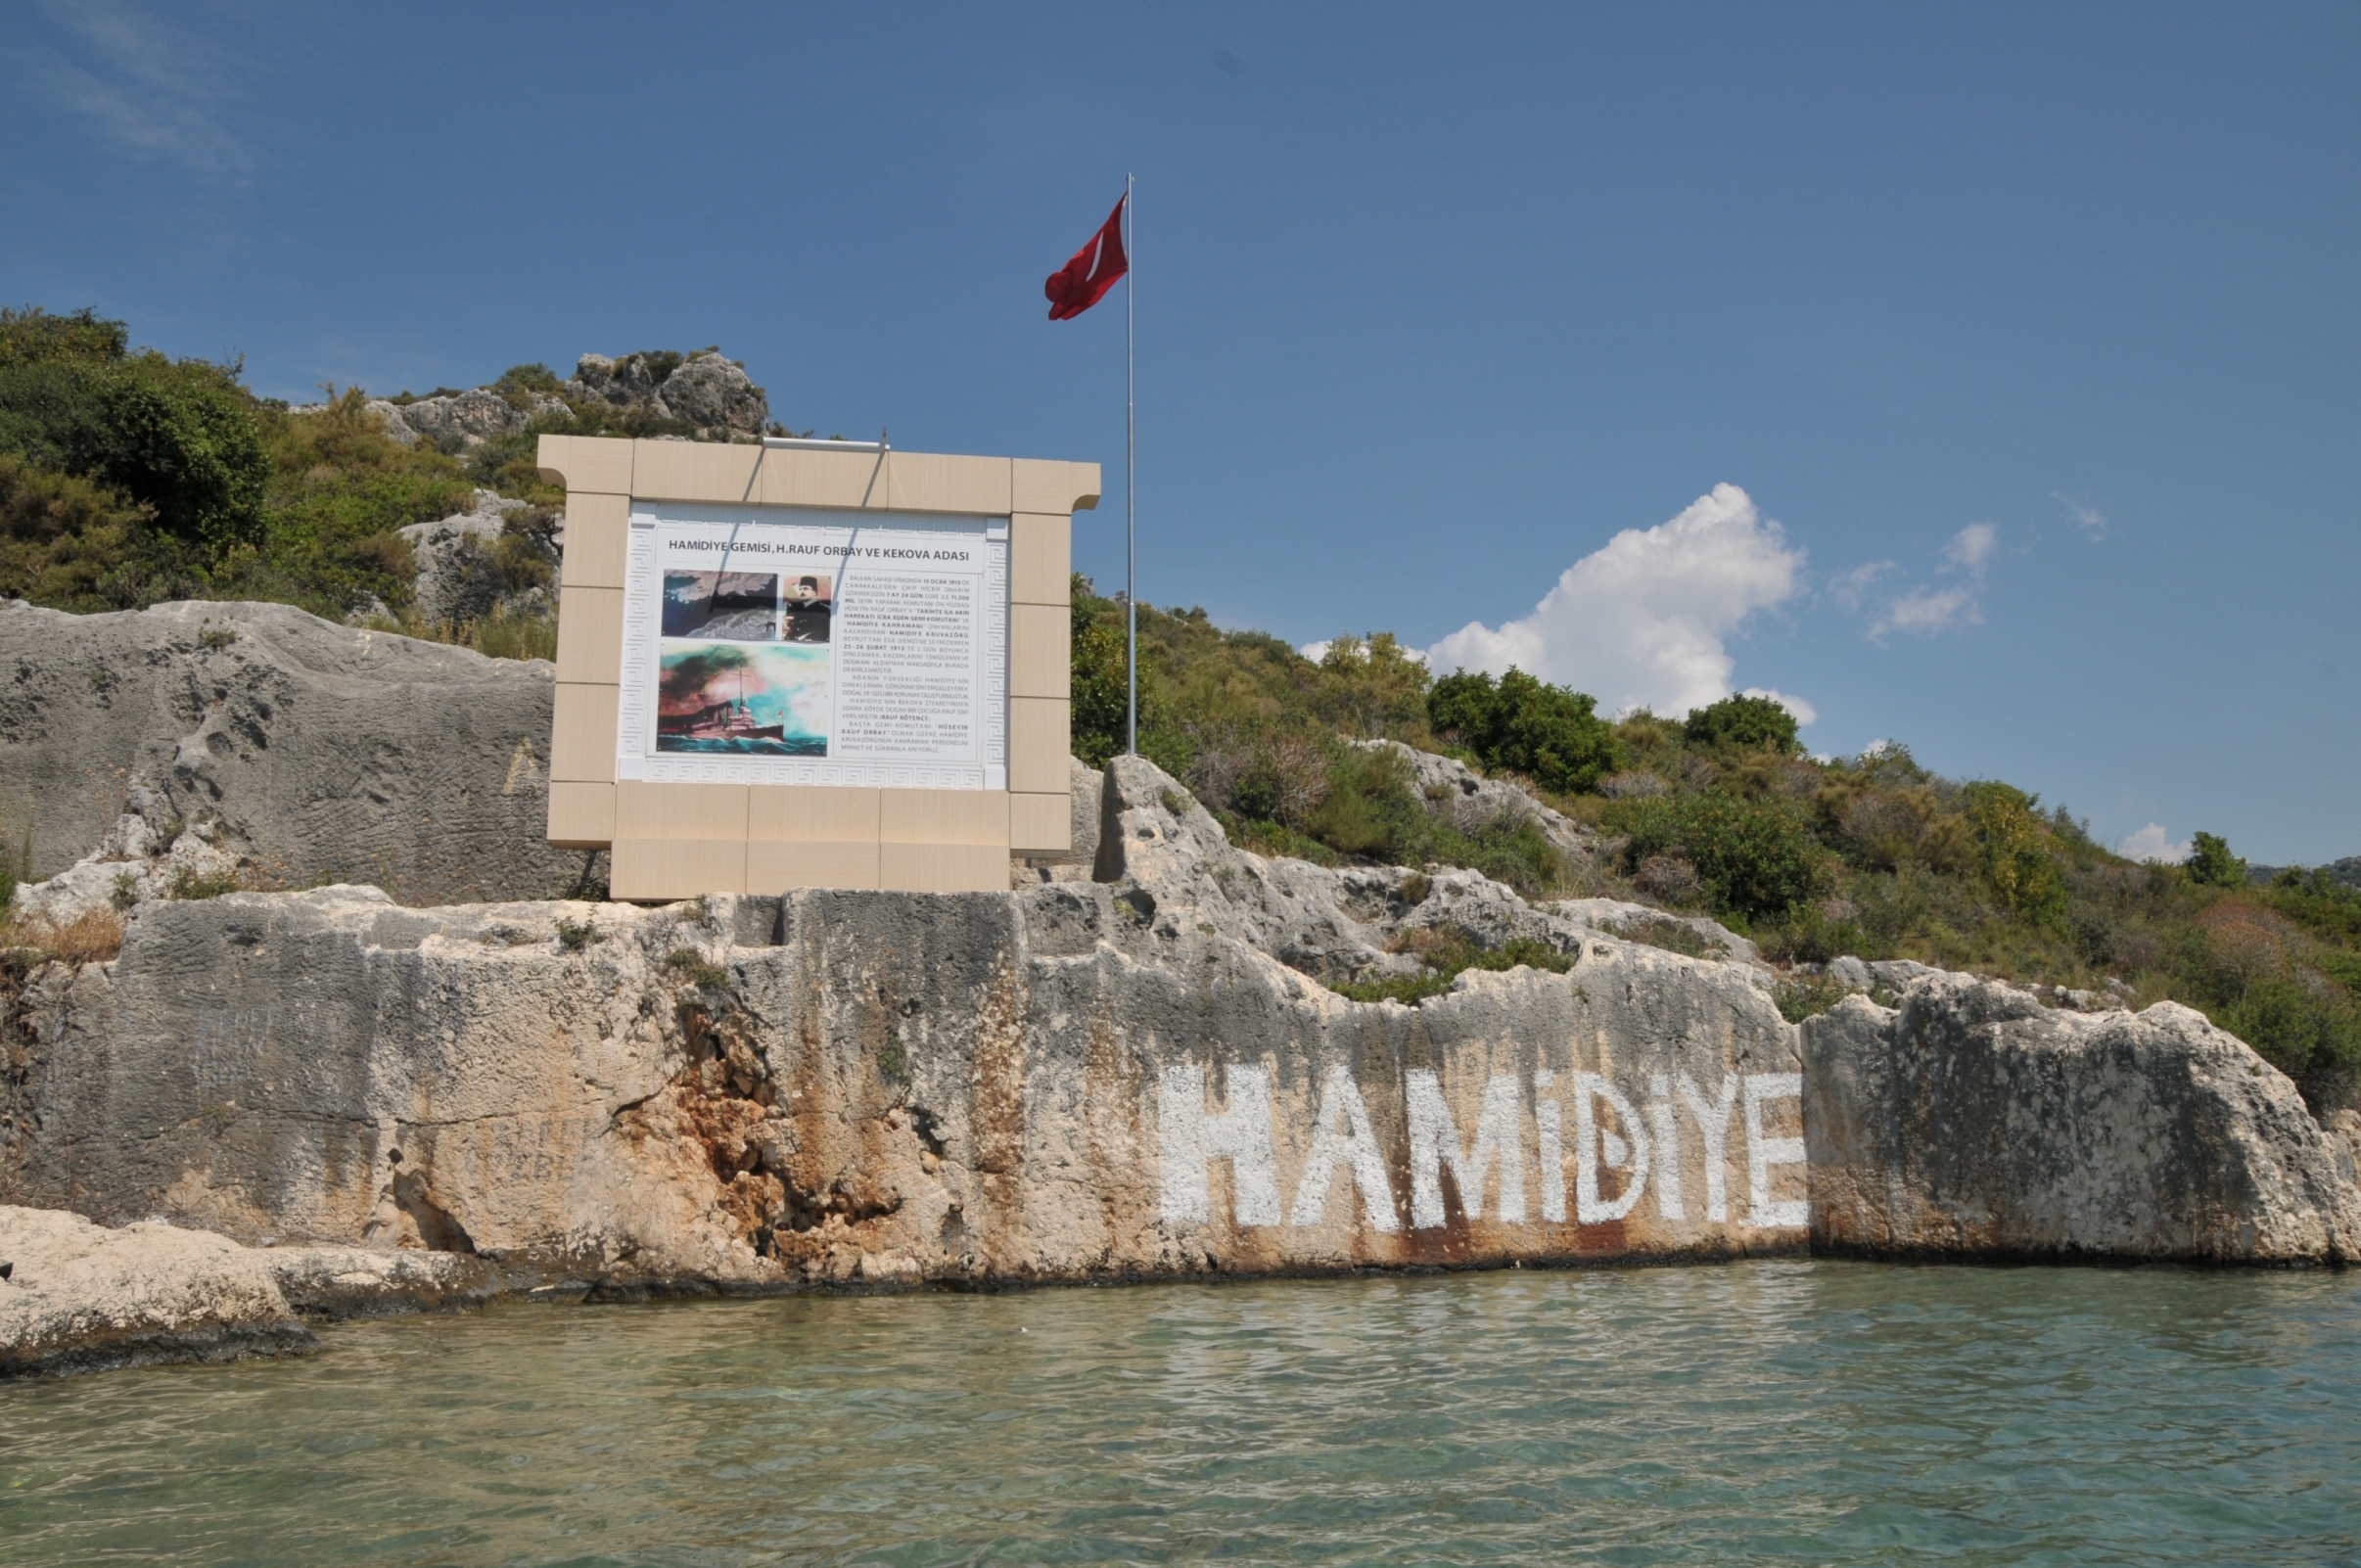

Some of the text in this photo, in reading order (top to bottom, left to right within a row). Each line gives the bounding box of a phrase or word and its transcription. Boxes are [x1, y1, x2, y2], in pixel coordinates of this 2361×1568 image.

[669, 539, 727, 550] HAMİDİYE
[823, 546, 862, 557] ORBAY
[865, 548, 880, 558] VE
[883, 548, 930, 560] KEKOVA
[933, 550, 969, 561] ADASI
